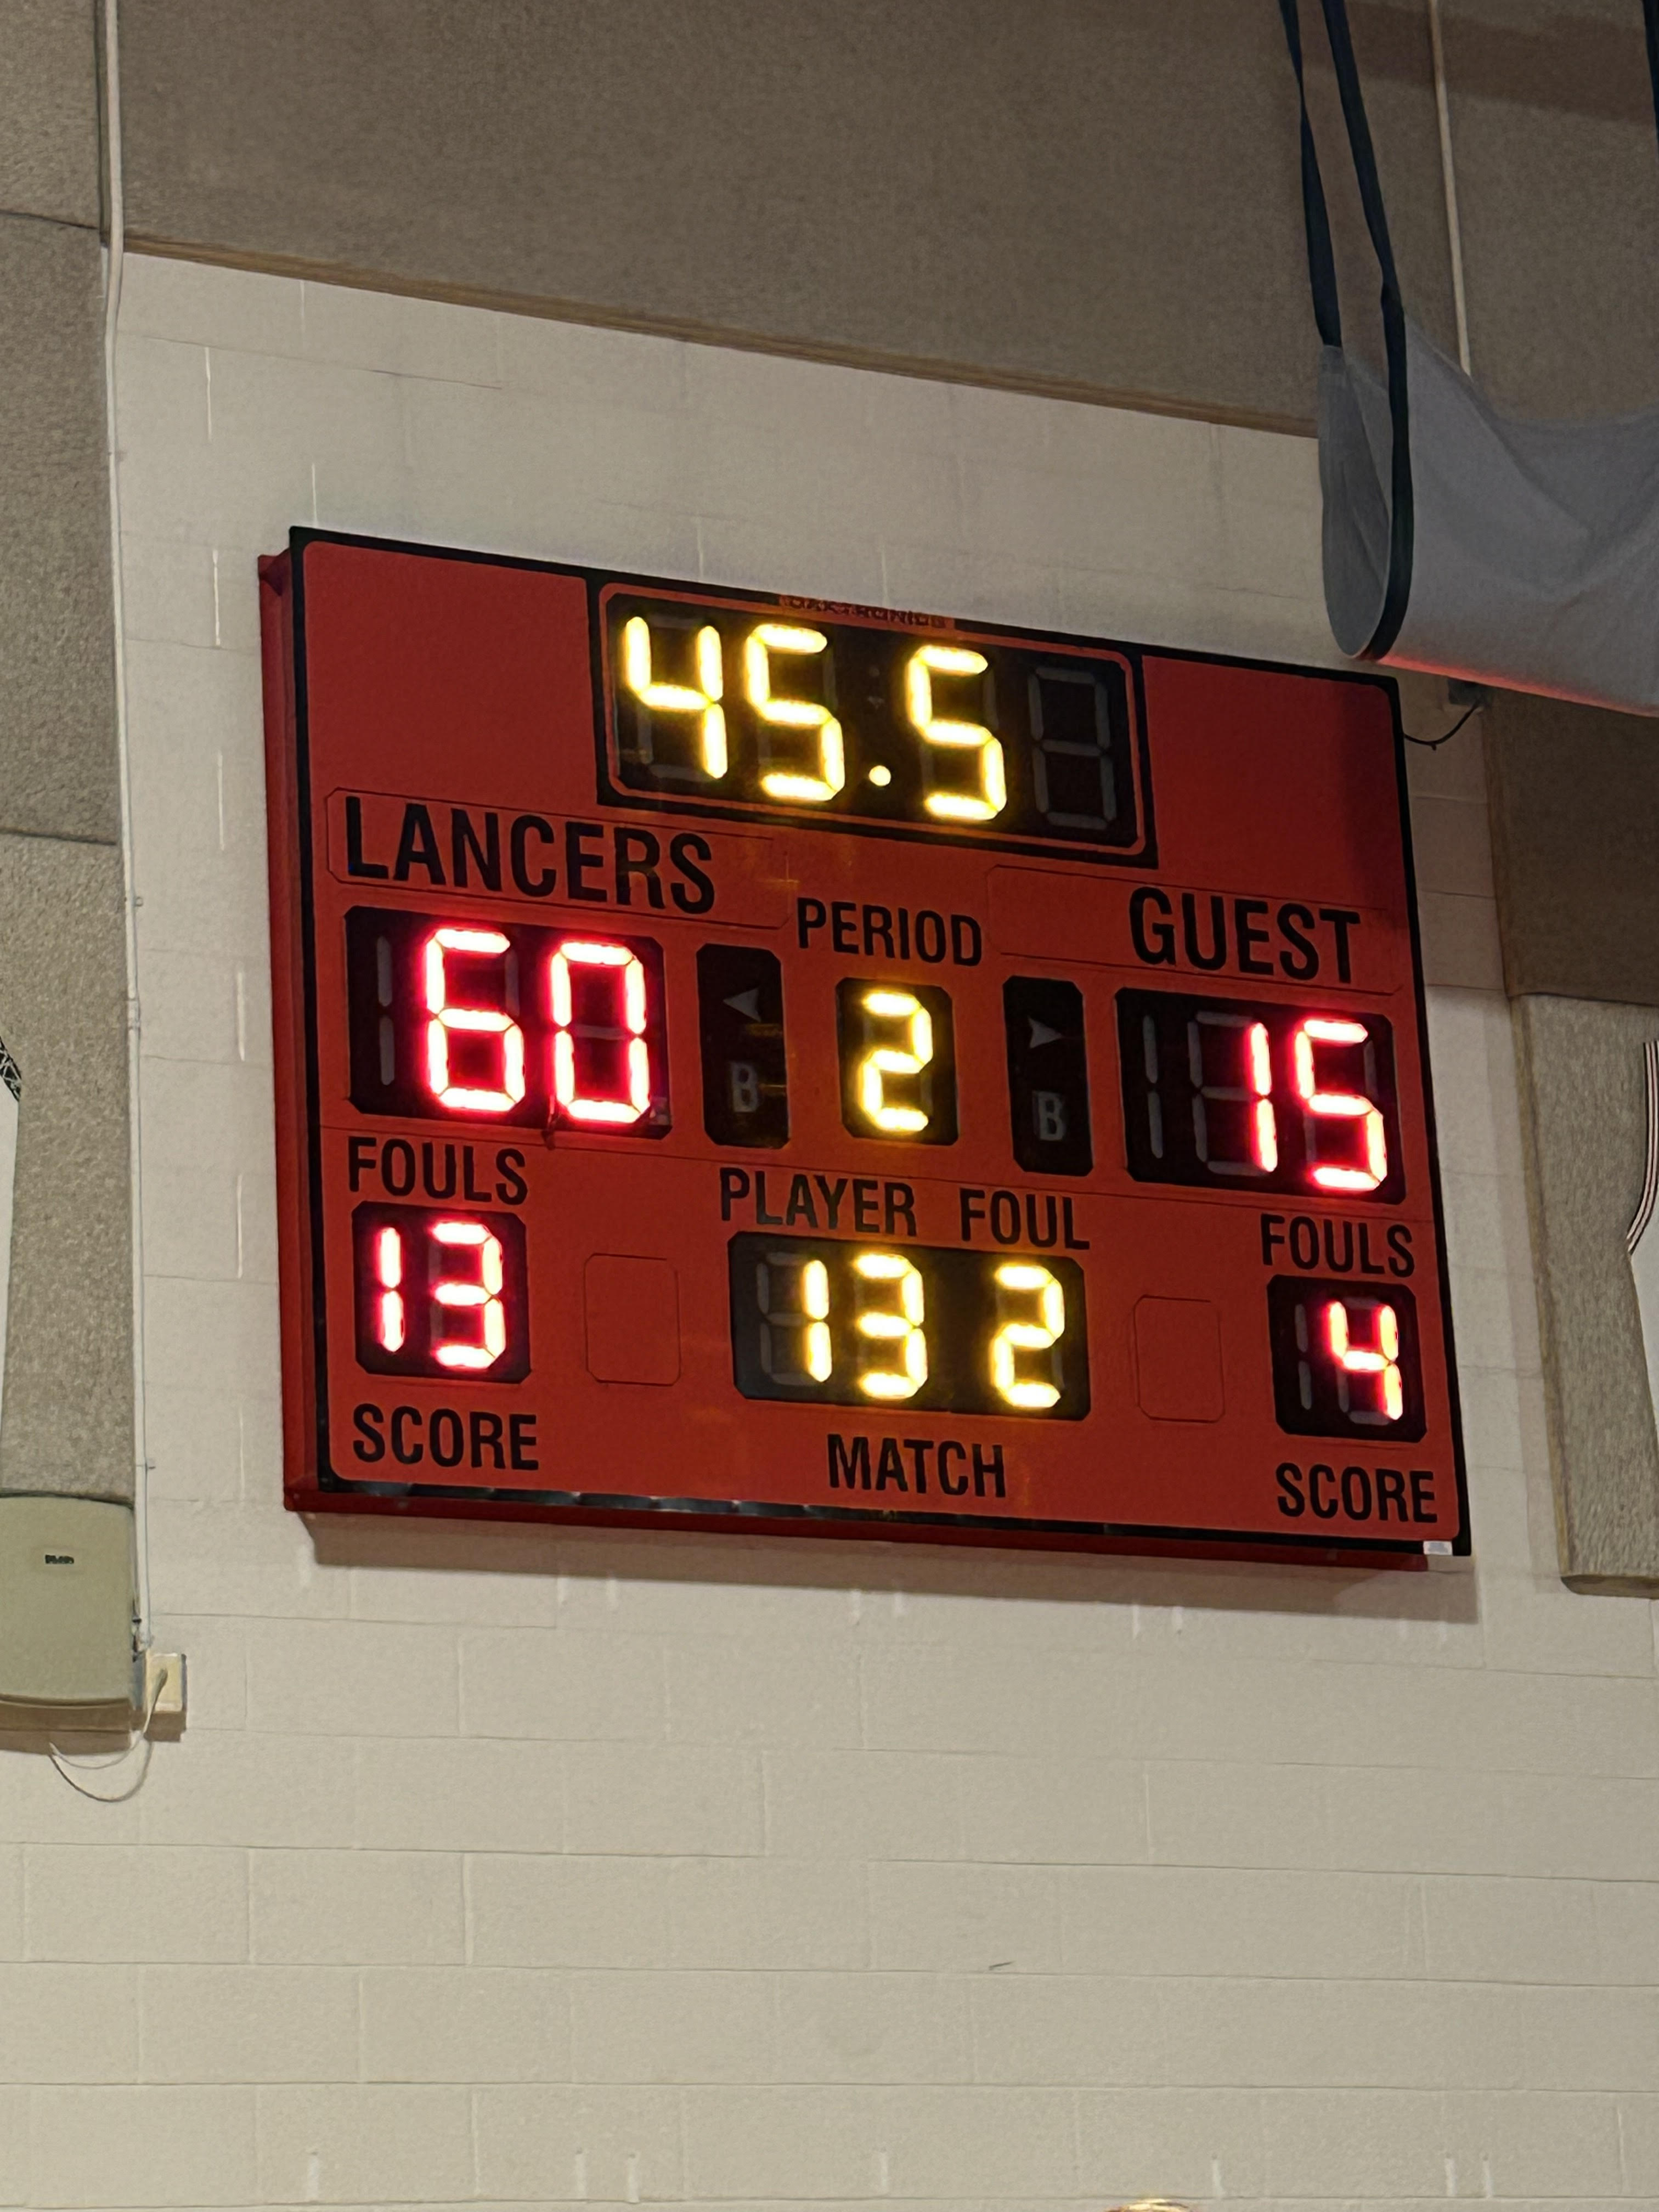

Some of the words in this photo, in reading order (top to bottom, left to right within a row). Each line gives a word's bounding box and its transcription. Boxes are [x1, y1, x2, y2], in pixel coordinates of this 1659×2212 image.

[624, 616, 1007, 821] 45.5
[345, 795, 715, 915] LANCERS
[797, 897, 982, 966] PERIOD
[1129, 887, 1361, 983] GUEST
[425, 928, 651, 1124] 60
[861, 991, 934, 1132] 2
[730, 1062, 759, 1113] B
[1036, 1092, 1066, 1142] B
[1250, 1019, 1388, 1191] 15
[348, 1137, 528, 1205] FOULS
[719, 1167, 917, 1237] PLAYER
[958, 1188, 1090, 1251] FOUL
[1260, 1213, 1415, 1278] FOULS
[379, 1221, 507, 1369] 13
[1328, 1300, 1403, 1420] 4
[352, 1403, 539, 1471] SCORE
[826, 1433, 1006, 1498] MATCH
[1275, 1462, 1438, 1524] SCORE
